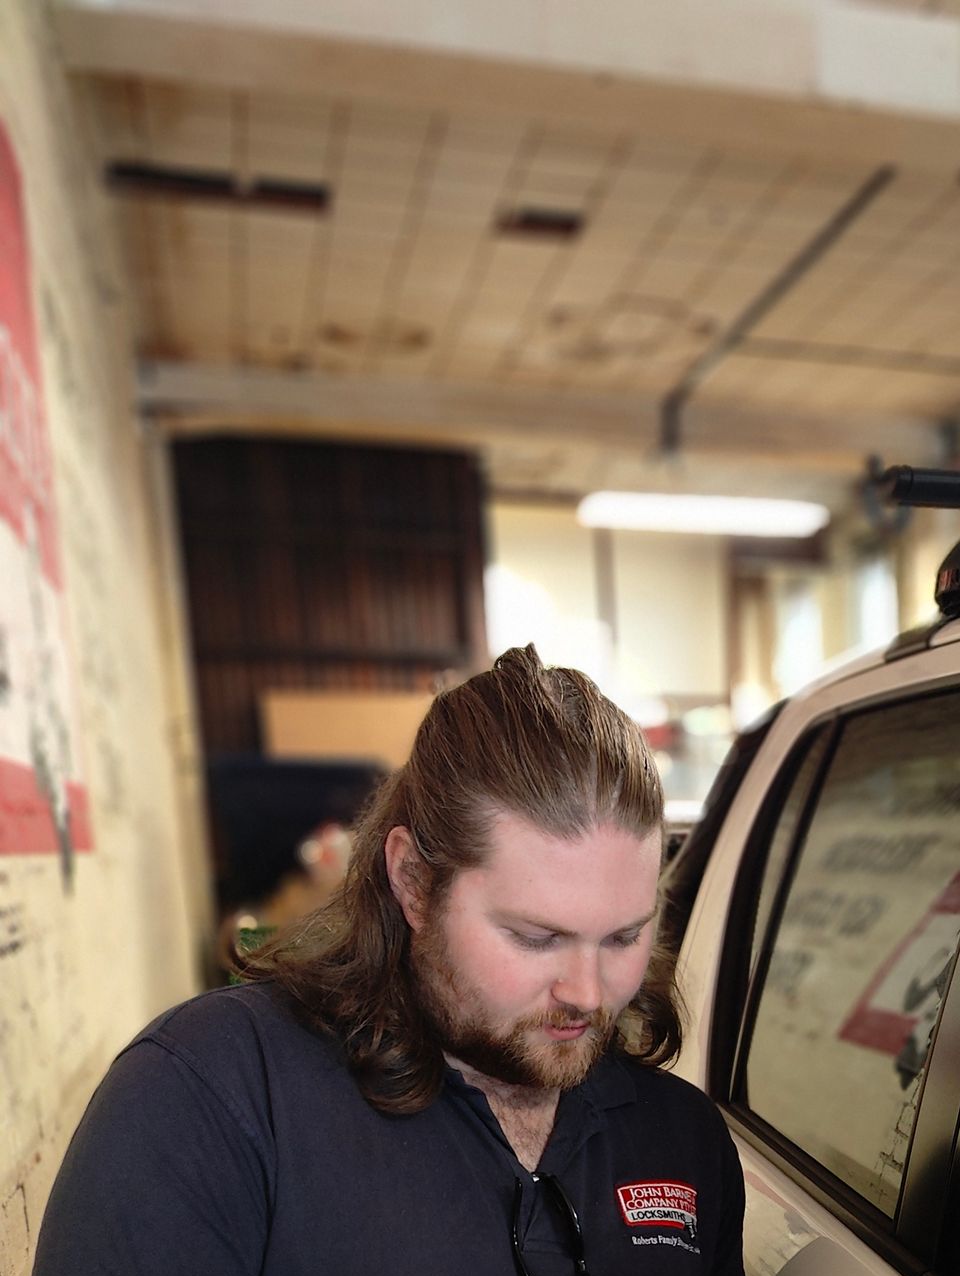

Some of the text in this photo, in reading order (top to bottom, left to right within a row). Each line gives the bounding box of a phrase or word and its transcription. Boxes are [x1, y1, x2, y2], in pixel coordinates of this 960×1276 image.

[629, 1187, 662, 1200] JOHN
[626, 1198, 679, 1210] COMPANY
[631, 1209, 686, 1220] LOCKSMITHS
